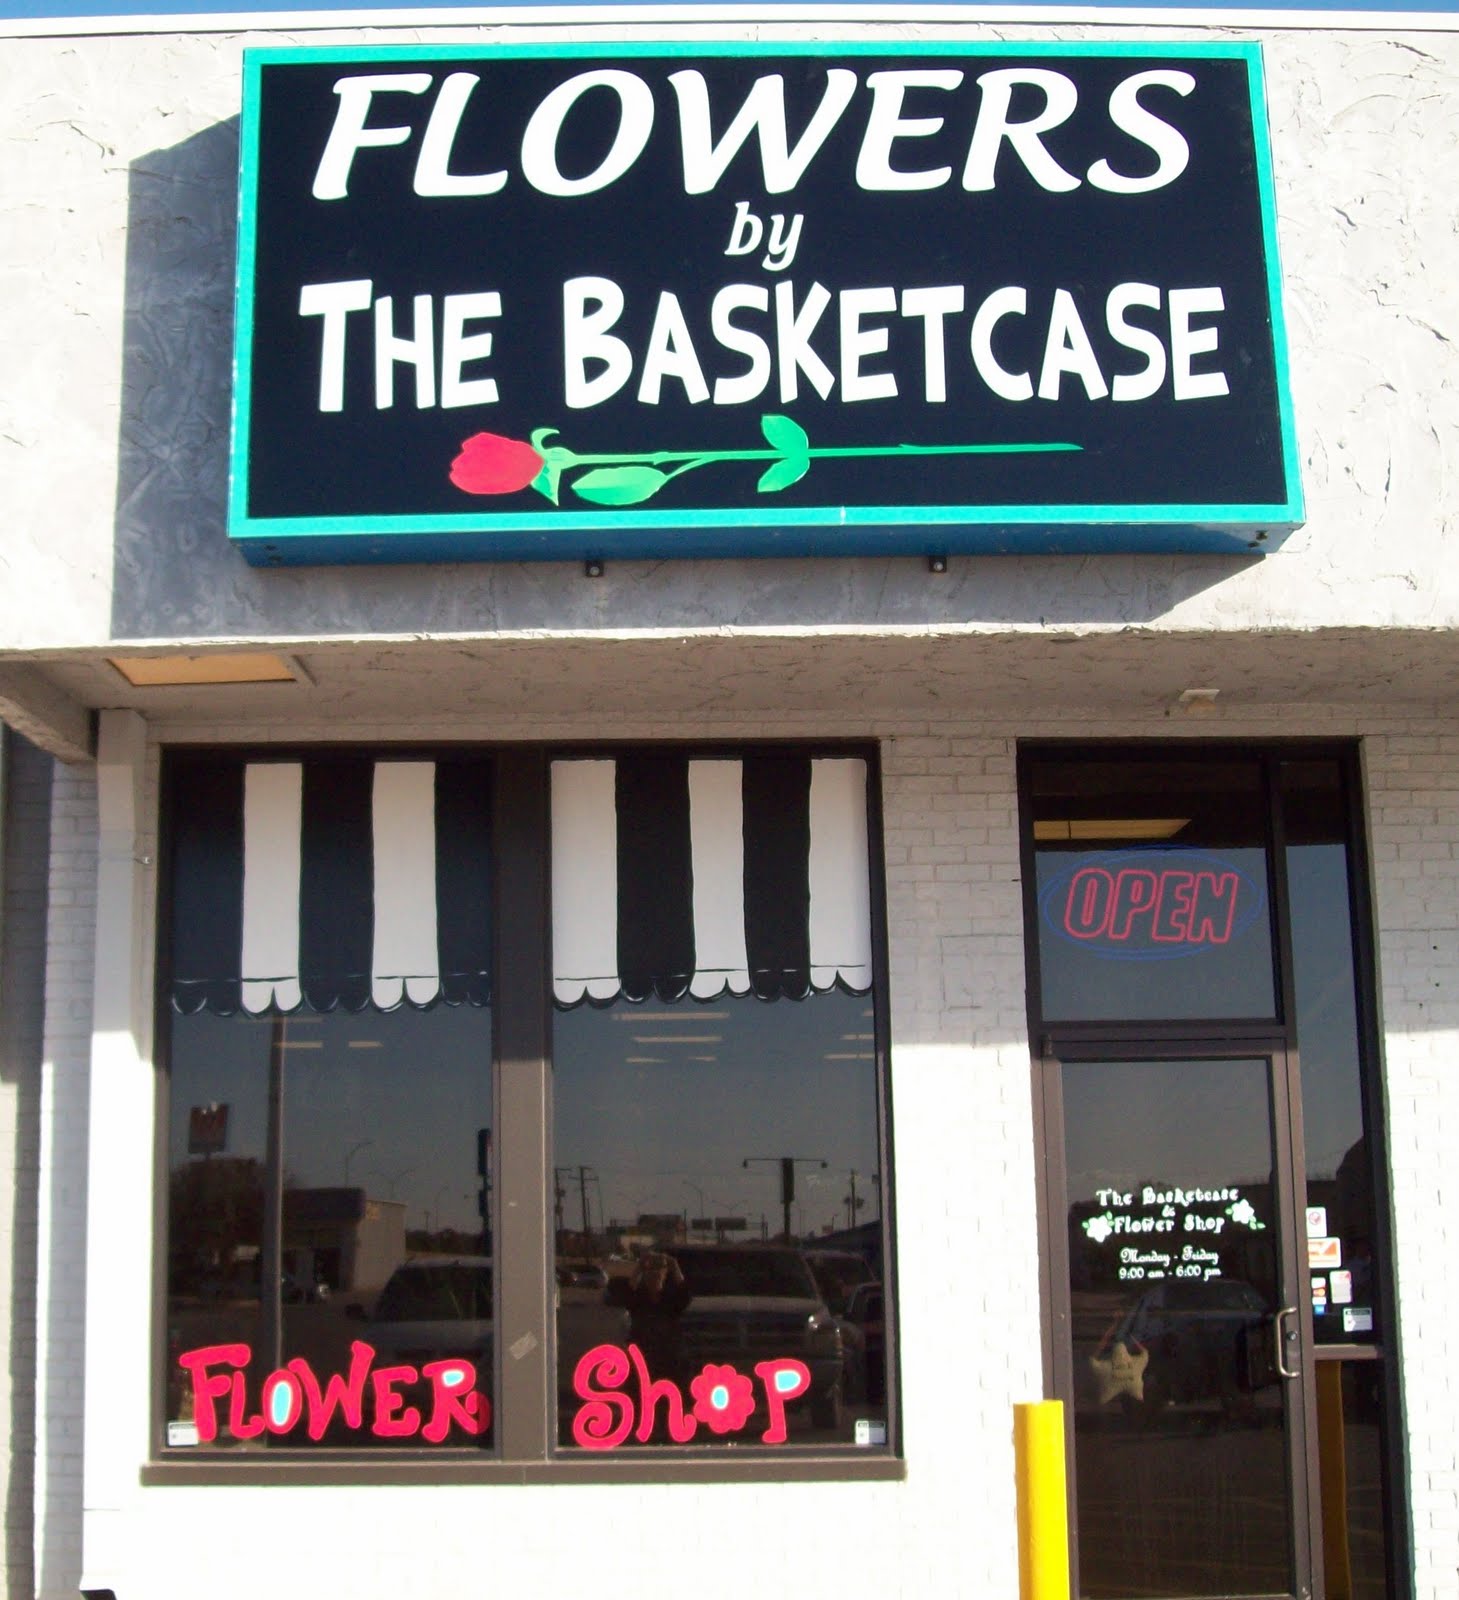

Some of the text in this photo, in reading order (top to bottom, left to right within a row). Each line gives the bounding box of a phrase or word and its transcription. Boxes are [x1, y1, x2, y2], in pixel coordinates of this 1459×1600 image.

[311, 68, 1197, 201] FLOWERS
[723, 201, 804, 272] by
[299, 276, 1231, 413] THE BASKETCASE
[1063, 866, 1239, 944] OPEN
[1096, 1185, 1240, 1208] The Basketcase
[1113, 1213, 1225, 1234] Flower Shop
[1118, 1266, 1145, 1280] 9:00
[1147, 1271, 1165, 1279] am
[1175, 1264, 1202, 1278] 6:00
[1204, 1269, 1222, 1282] pm
[1119, 1246, 1171, 1267] Monday
[1181, 1245, 1219, 1266] Friday
[179, 1339, 491, 1443] FLOWER
